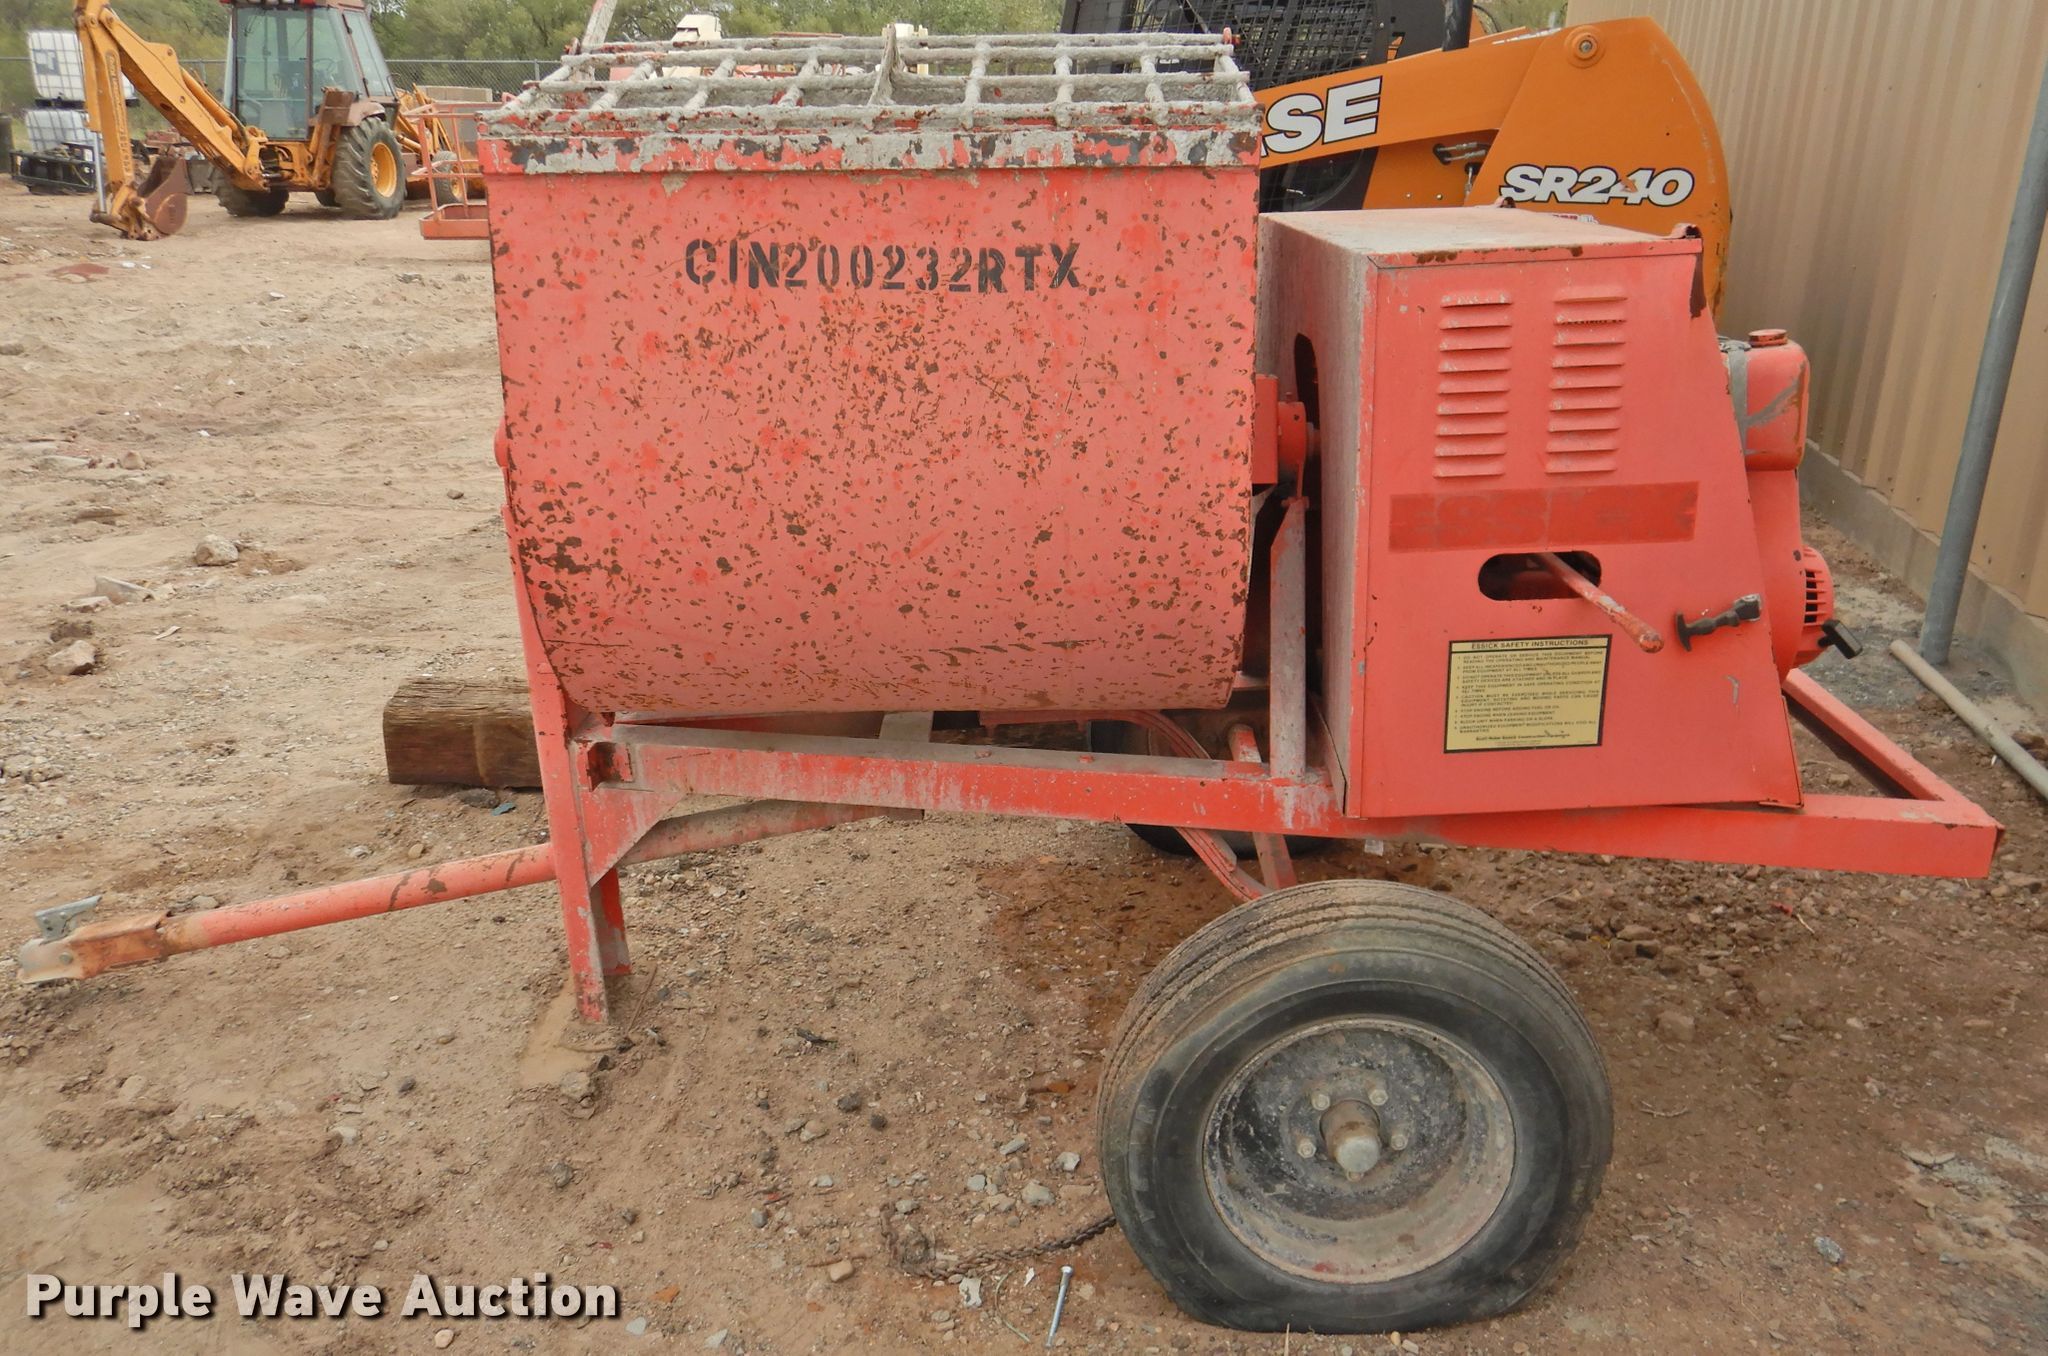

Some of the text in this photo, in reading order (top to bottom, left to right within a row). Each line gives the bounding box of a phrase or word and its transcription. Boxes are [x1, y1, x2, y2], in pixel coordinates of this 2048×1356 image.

[1260, 75, 1383, 157] SE
[1499, 163, 1695, 207] SR240
[685, 238, 1081, 293] CIN200232RTX
[1471, 639, 1589, 650] ESSICK SAFETY INSTRUCTIONS
